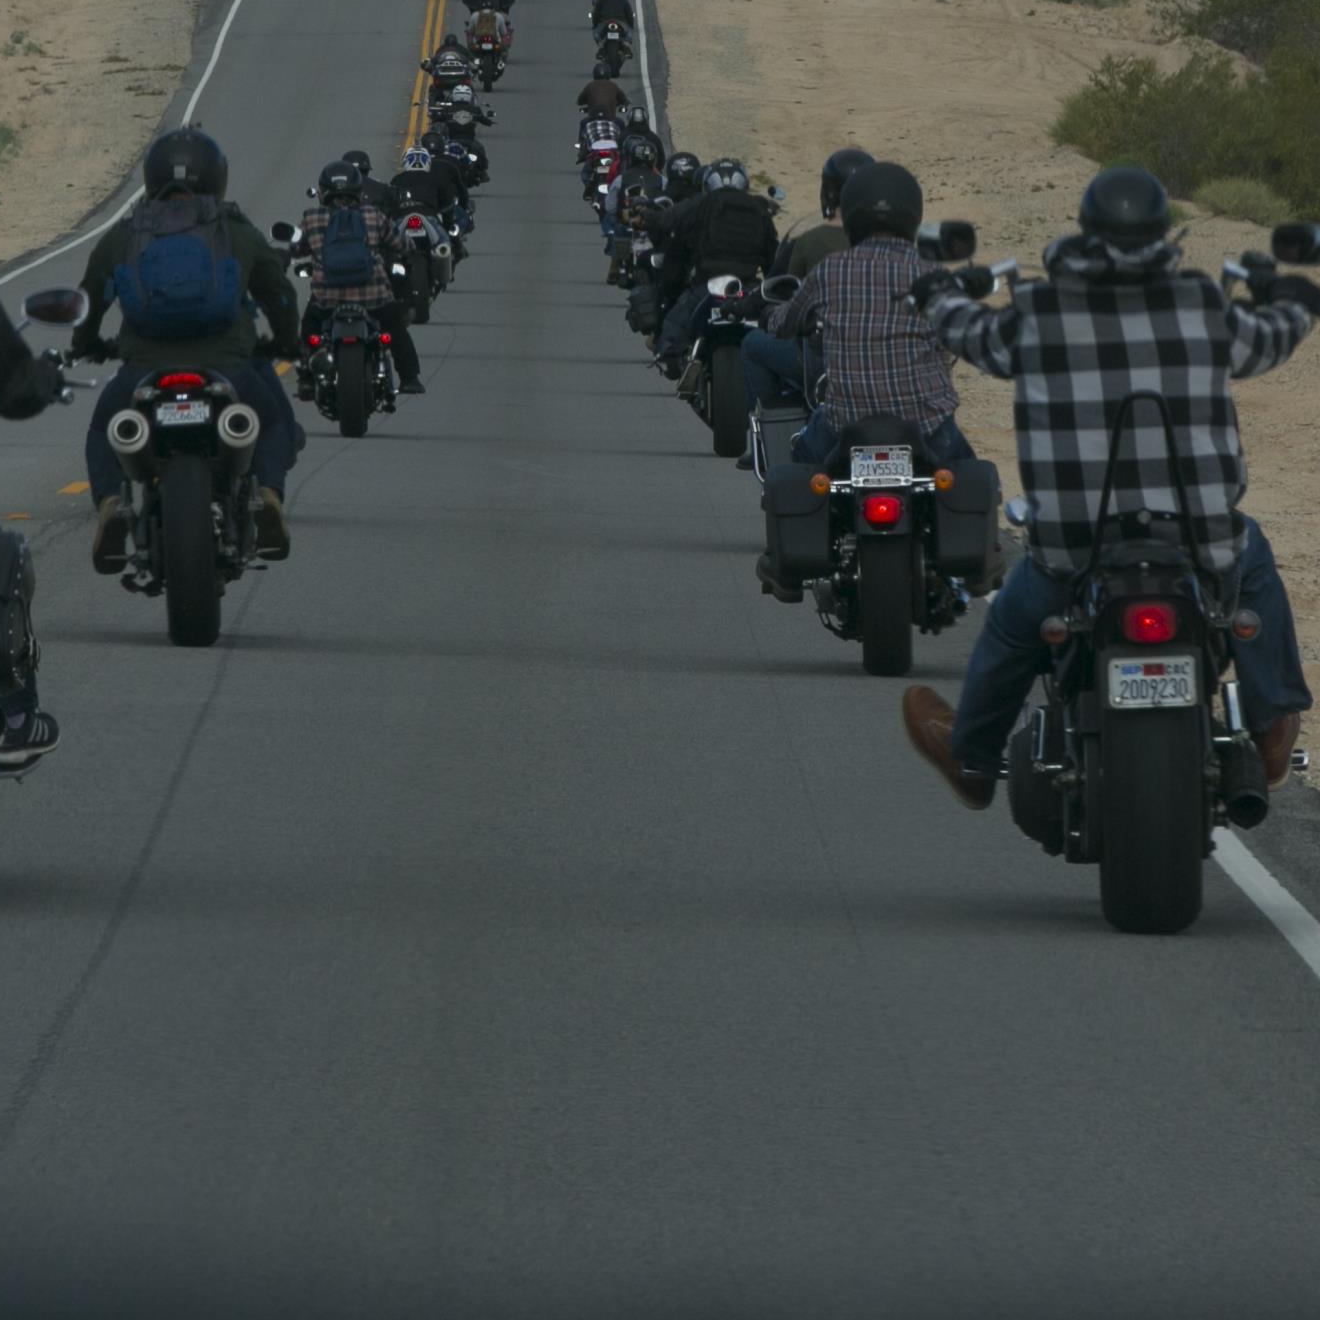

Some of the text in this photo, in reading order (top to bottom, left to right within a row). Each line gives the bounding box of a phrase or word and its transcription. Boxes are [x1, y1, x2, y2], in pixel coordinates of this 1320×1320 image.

[859, 463, 905, 476] 21V5533
[1165, 664, 1189, 675] CAL
[1120, 677, 1188, 700] 20D9230
